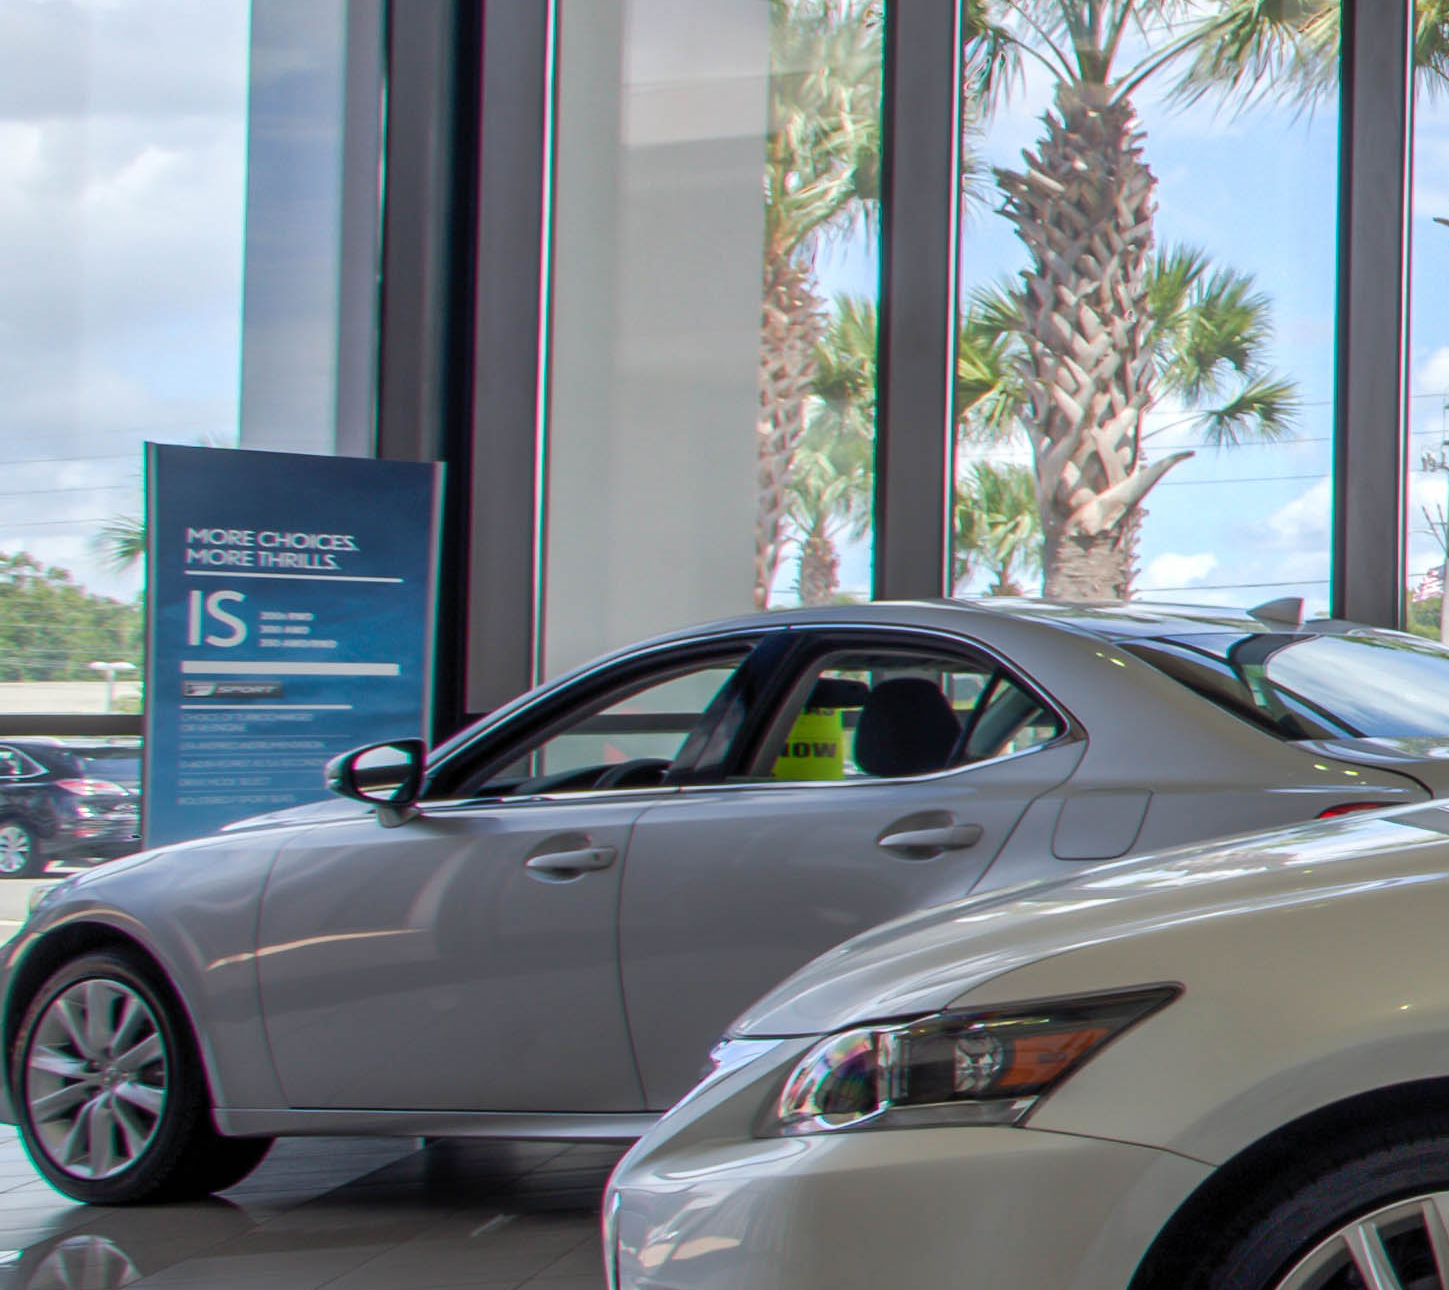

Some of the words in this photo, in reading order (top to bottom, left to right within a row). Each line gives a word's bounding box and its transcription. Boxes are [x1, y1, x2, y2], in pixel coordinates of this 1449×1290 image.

[187, 527, 255, 547] MORE
[257, 530, 360, 552] CHOICES.
[187, 548, 254, 567] MORE
[256, 550, 341, 570] THRILLS.
[189, 589, 248, 648] IS
